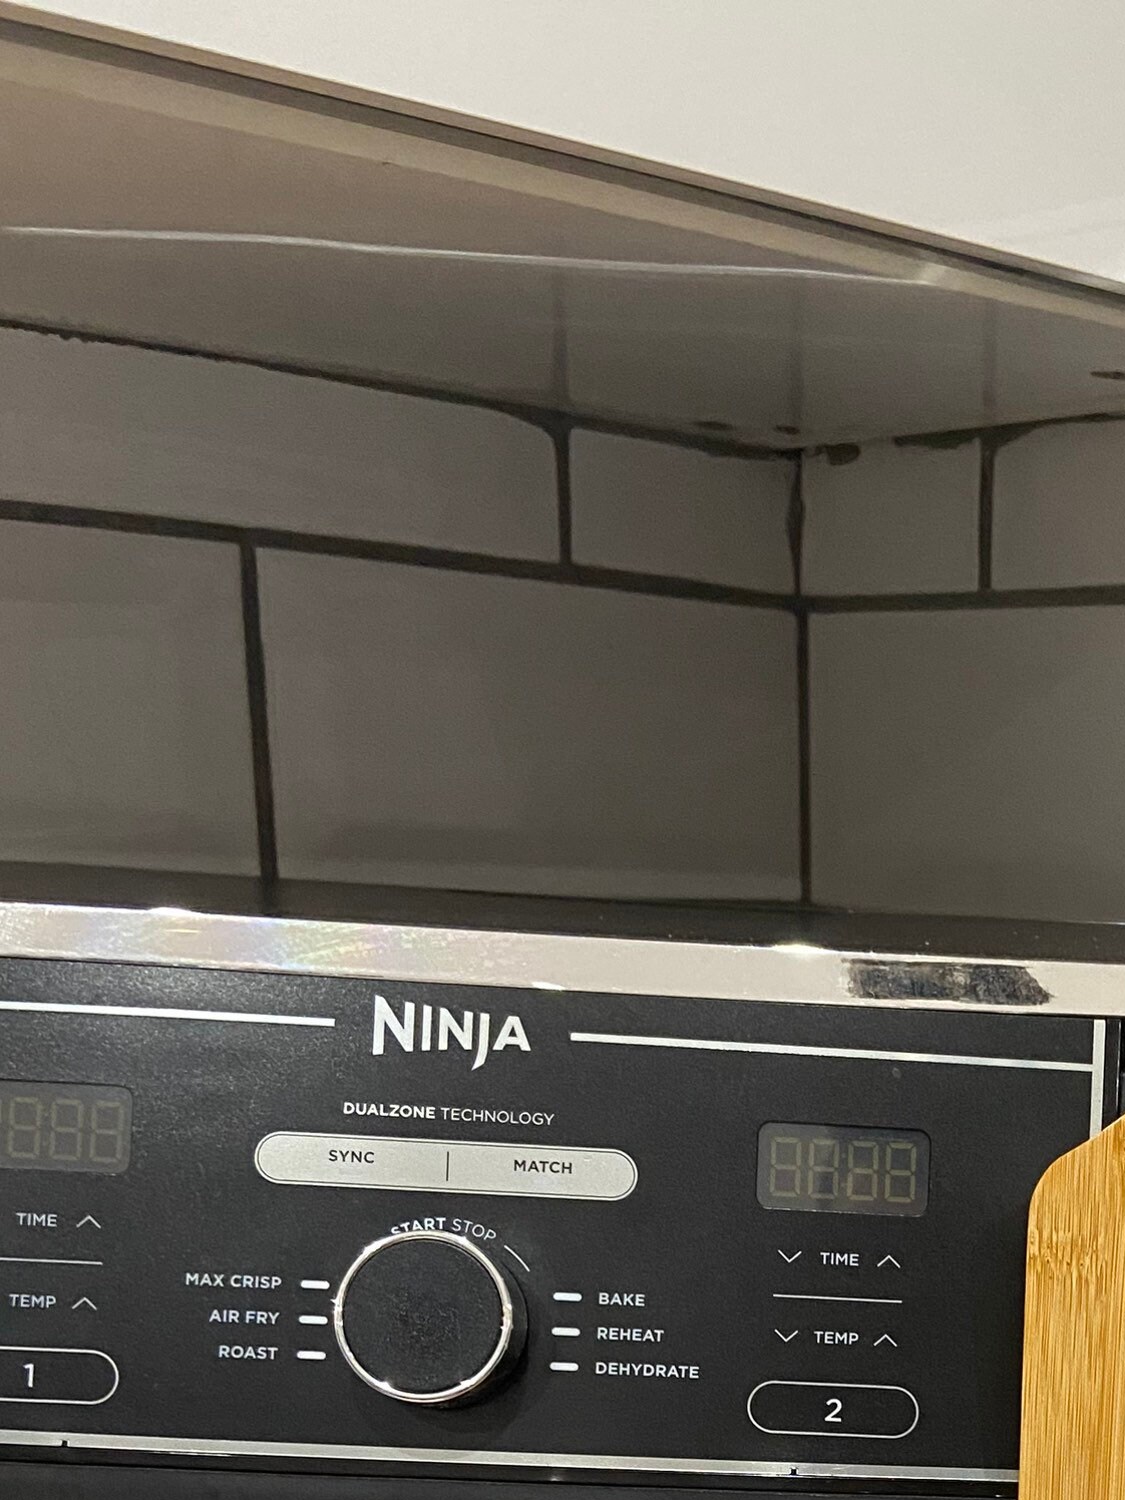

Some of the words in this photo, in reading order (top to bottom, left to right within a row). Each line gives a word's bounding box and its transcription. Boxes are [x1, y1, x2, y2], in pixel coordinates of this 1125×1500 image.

[372, 995, 531, 1070] NINJA
[343, 1102, 436, 1120] DUALZONE
[441, 1107, 555, 1126] TECHNOLOGY
[328, 1149, 375, 1165] SYNC
[513, 1159, 573, 1175] MATCH
[16, 1212, 58, 1227] TIME
[451, 1218, 496, 1241] STOP
[820, 1252, 859, 1267] TIME
[185, 1272, 226, 1288] MAX
[233, 1274, 282, 1290] CRISP
[9, 1294, 57, 1308] TEMP
[598, 1292, 645, 1307] BAKE
[209, 1309, 241, 1324] AIR
[246, 1310, 280, 1325] FRY
[597, 1327, 664, 1343] REHEAT
[814, 1331, 859, 1346] TEMP
[218, 1345, 278, 1360] ROAST
[23, 1363, 35, 1388] 1
[595, 1361, 700, 1379] DEHYDRATE
[824, 1398, 842, 1422] 2
